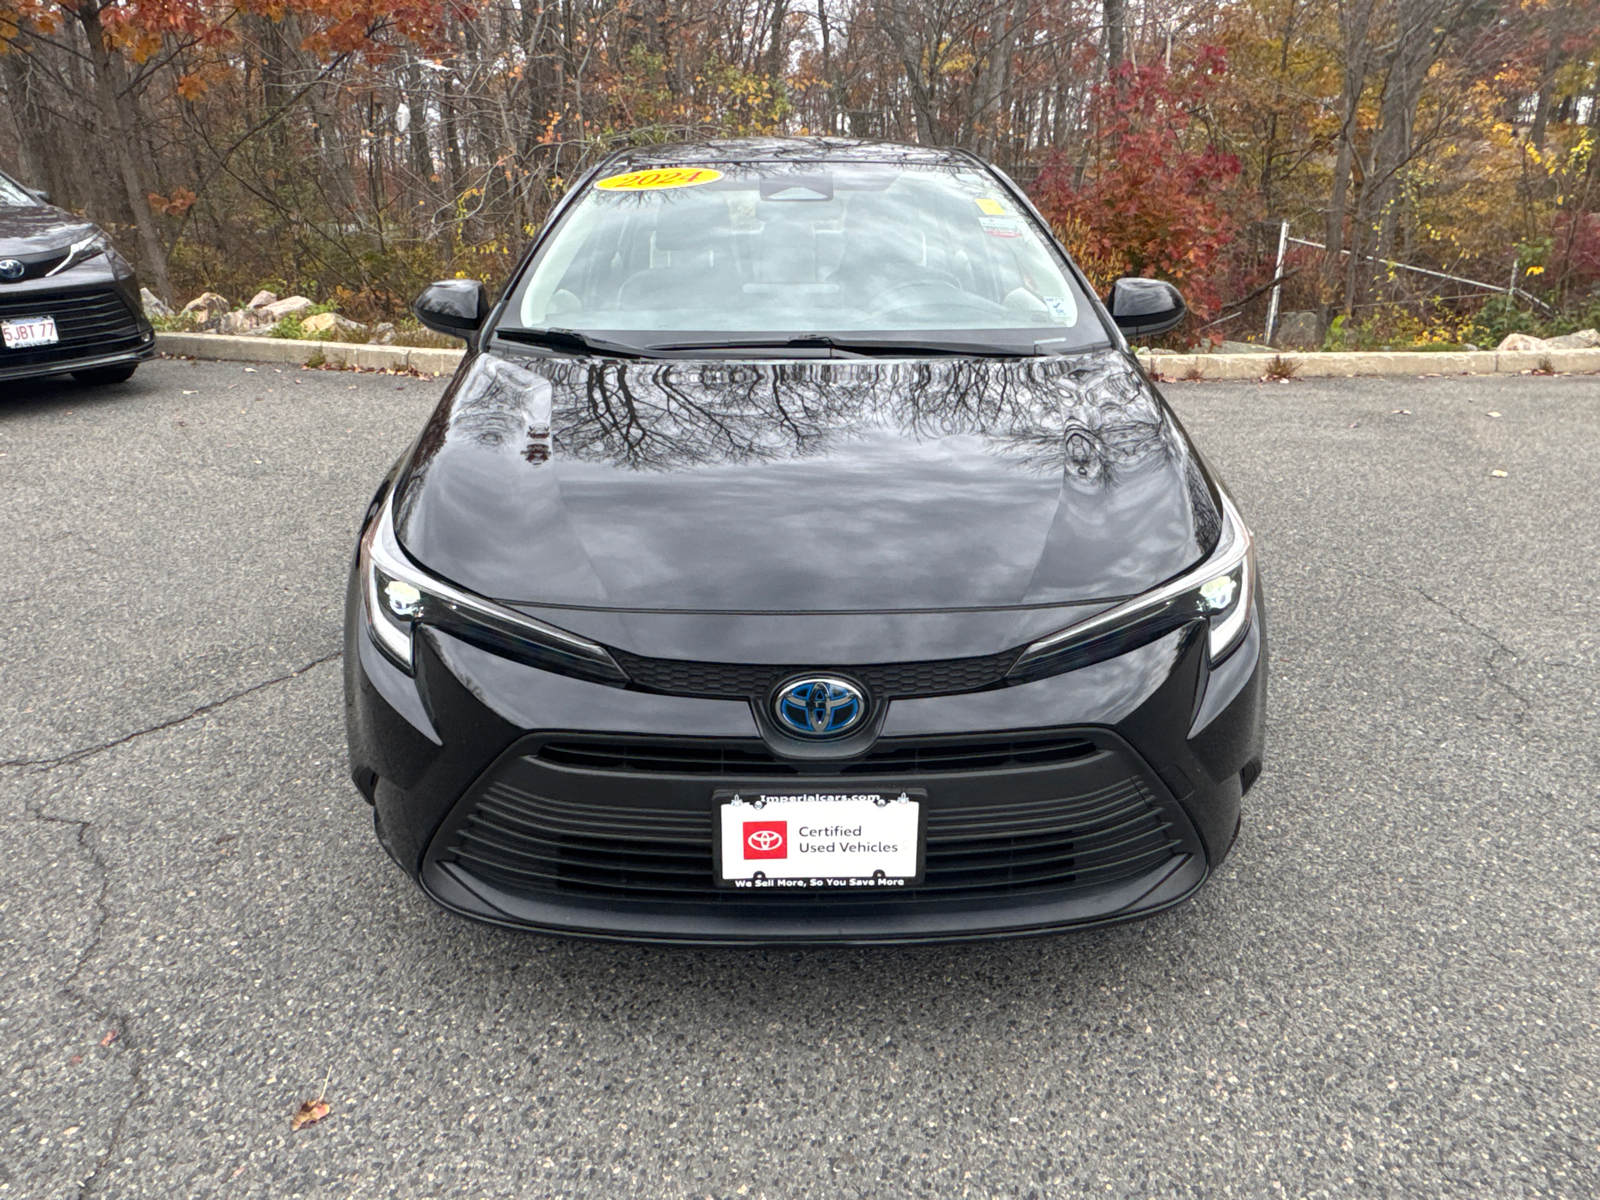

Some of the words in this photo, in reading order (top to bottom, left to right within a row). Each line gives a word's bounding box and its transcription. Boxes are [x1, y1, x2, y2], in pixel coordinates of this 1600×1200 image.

[614, 171, 703, 187] 2024
[39, 322, 54, 337] 77
[799, 825, 862, 837] Certified
[799, 842, 836, 853] Used
[839, 841, 898, 853] Vehicles
[735, 880, 752, 888] We
[755, 879, 775, 888] Sell
[777, 879, 807, 888] More,
[810, 879, 823, 887] So
[826, 878, 847, 887] You
[849, 878, 875, 887] Save
[877, 878, 904, 887] More
